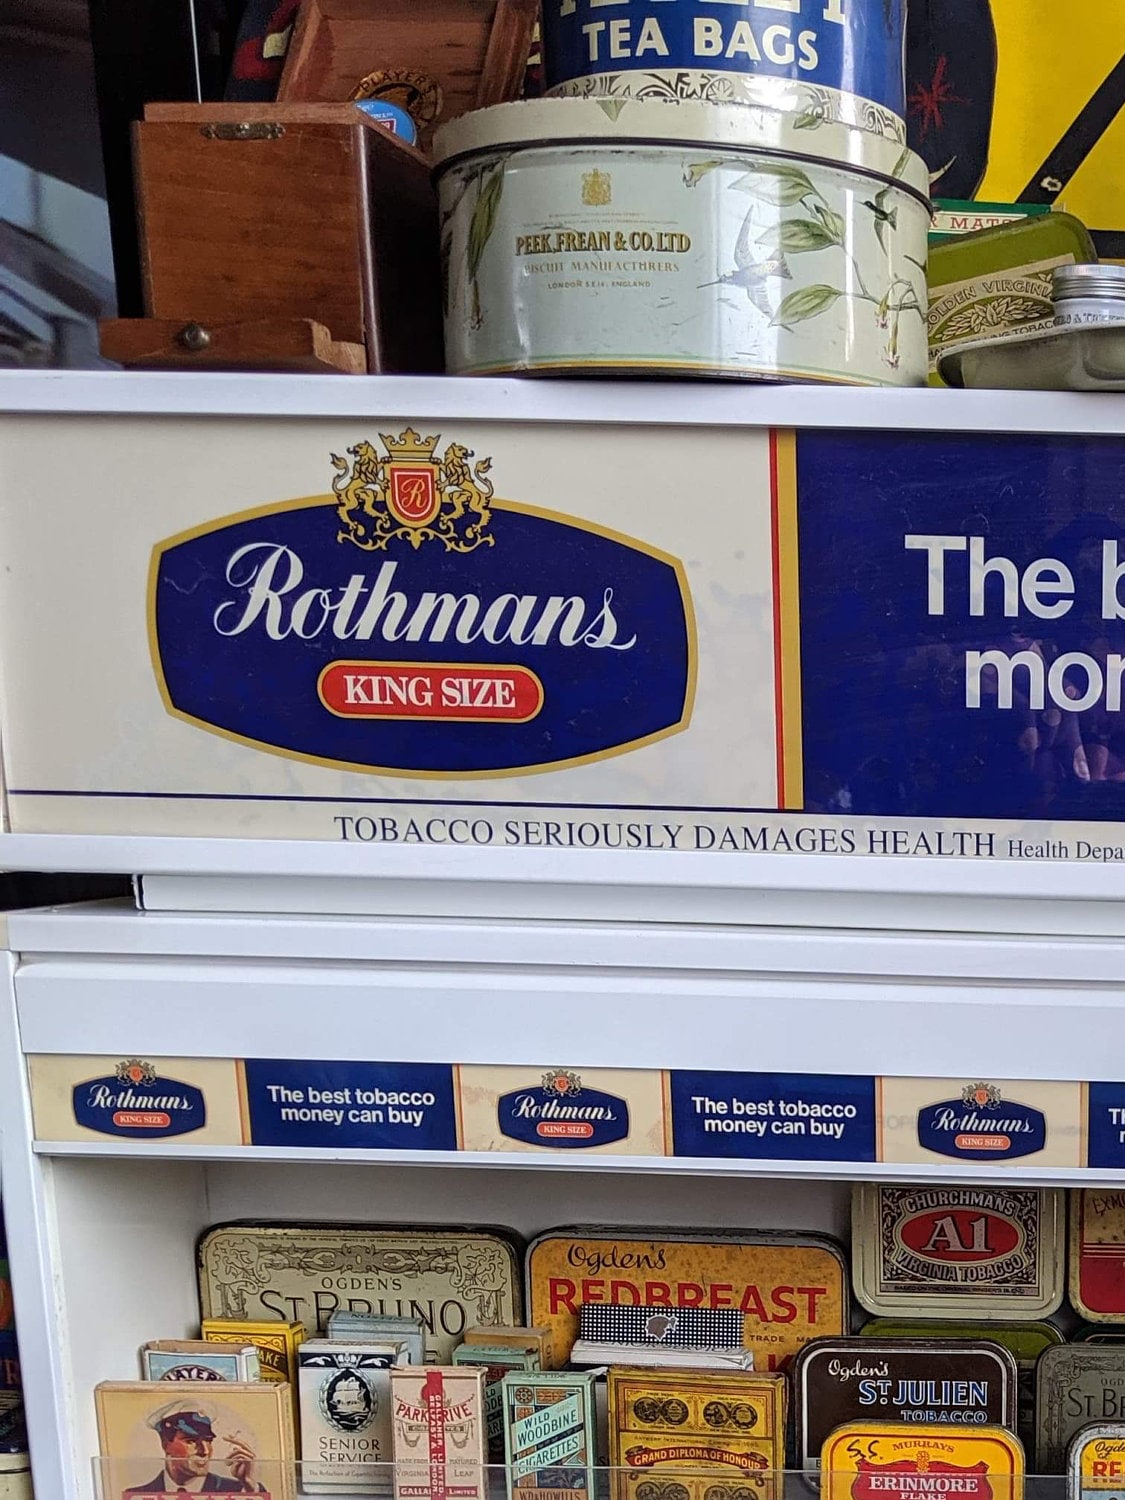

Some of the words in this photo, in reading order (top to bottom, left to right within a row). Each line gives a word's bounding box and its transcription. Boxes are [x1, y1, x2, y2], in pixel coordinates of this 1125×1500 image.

[582, 17, 670, 60] TEA
[693, 23, 819, 70] BAGS
[905, 533, 1075, 618] The
[213, 542, 636, 649] Rothmans
[344, 674, 434, 706] KING
[442, 676, 516, 709] SIZE
[334, 815, 493, 844] TOBACCO
[504, 820, 682, 849] SERIOUSLY
[693, 824, 856, 853] DAMAGES
[868, 829, 994, 857] HEALTH
[1008, 838, 1069, 859] Health
[87, 1085, 194, 1111] Rothmans
[267, 1085, 305, 1103] The
[308, 1087, 350, 1105] best
[354, 1089, 435, 1107] tobacco
[511, 1096, 617, 1122] Rothmans
[932, 1108, 1035, 1134] Rothmans
[922, 1215, 993, 1254] A1
[568, 1243, 666, 1275] Ogden's
[898, 1250, 958, 1281] VIRGINIA
[958, 1256, 1024, 1282] TOBACCO
[321, 1277, 402, 1291] OGDEN'S
[549, 1278, 826, 1325] REDBREAST
[828, 1358, 889, 1381] Ogden's
[893, 1380, 988, 1407] JULIEN
[517, 1409, 578, 1447] WOODBINE
[524, 1412, 550, 1428] WILD
[901, 1410, 988, 1424] TOBACCO
[319, 1436, 380, 1451] SENIOR
[518, 1436, 580, 1475] CIGARETTES
[868, 1476, 979, 1493] ERINMORE
[900, 1493, 946, 1500] FLAKE
